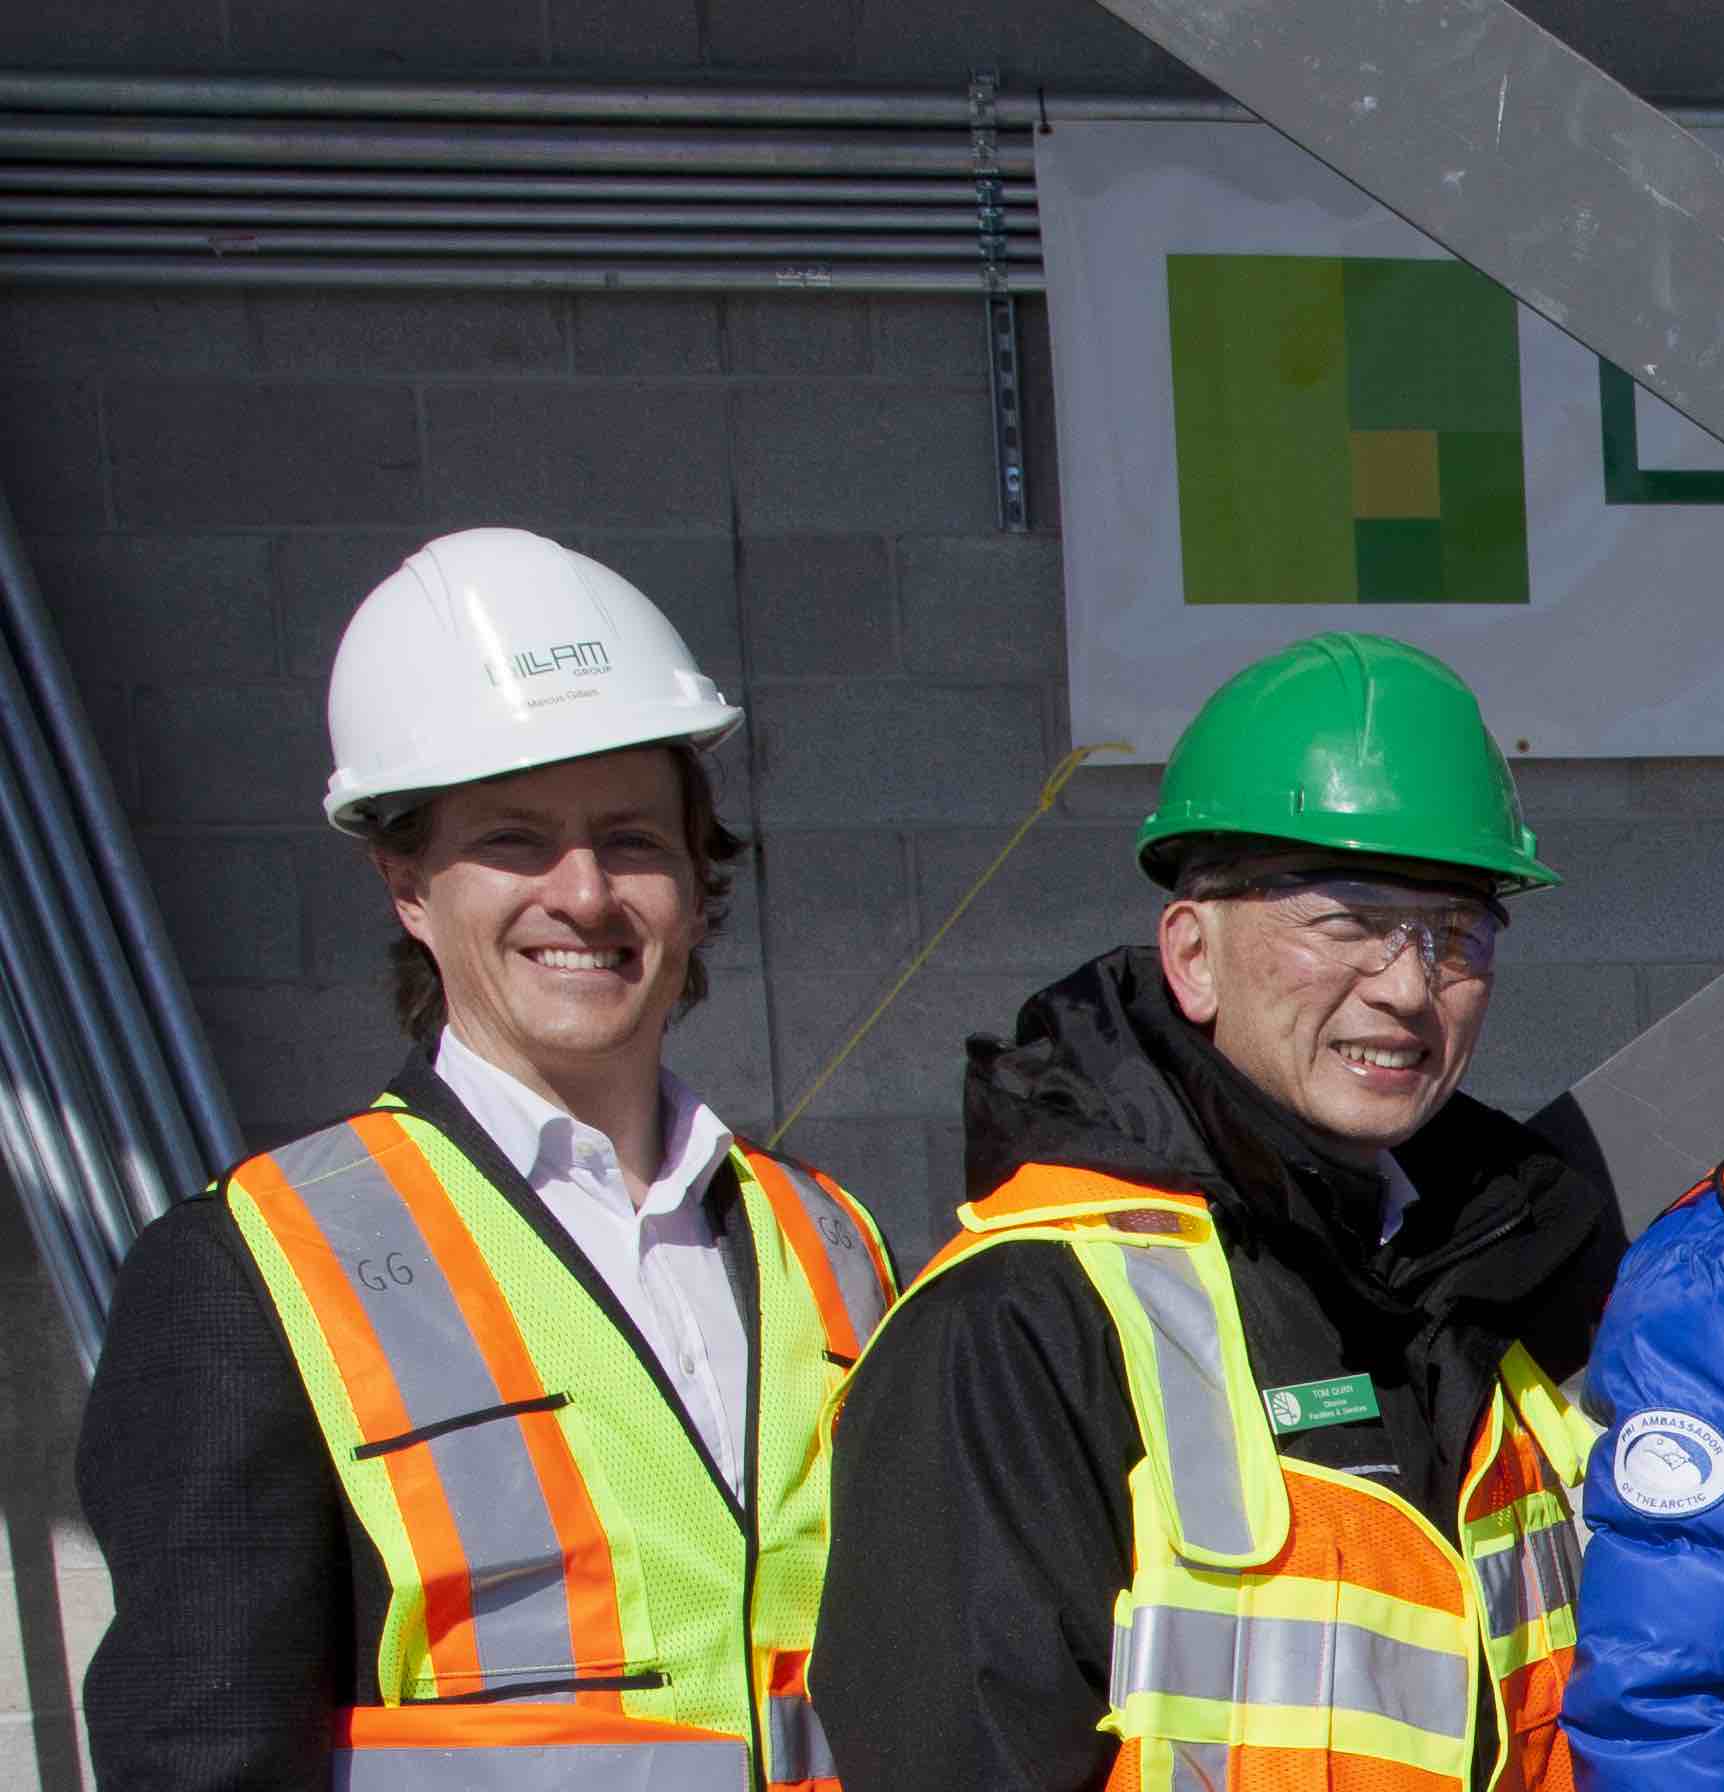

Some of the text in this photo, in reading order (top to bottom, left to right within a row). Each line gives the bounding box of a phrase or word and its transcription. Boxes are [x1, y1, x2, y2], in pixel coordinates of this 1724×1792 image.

[1641, 1415, 1724, 1456] AMBASSADOR
[1635, 1492, 1658, 1508] THE
[1660, 1492, 1707, 1509] ARCTIC
